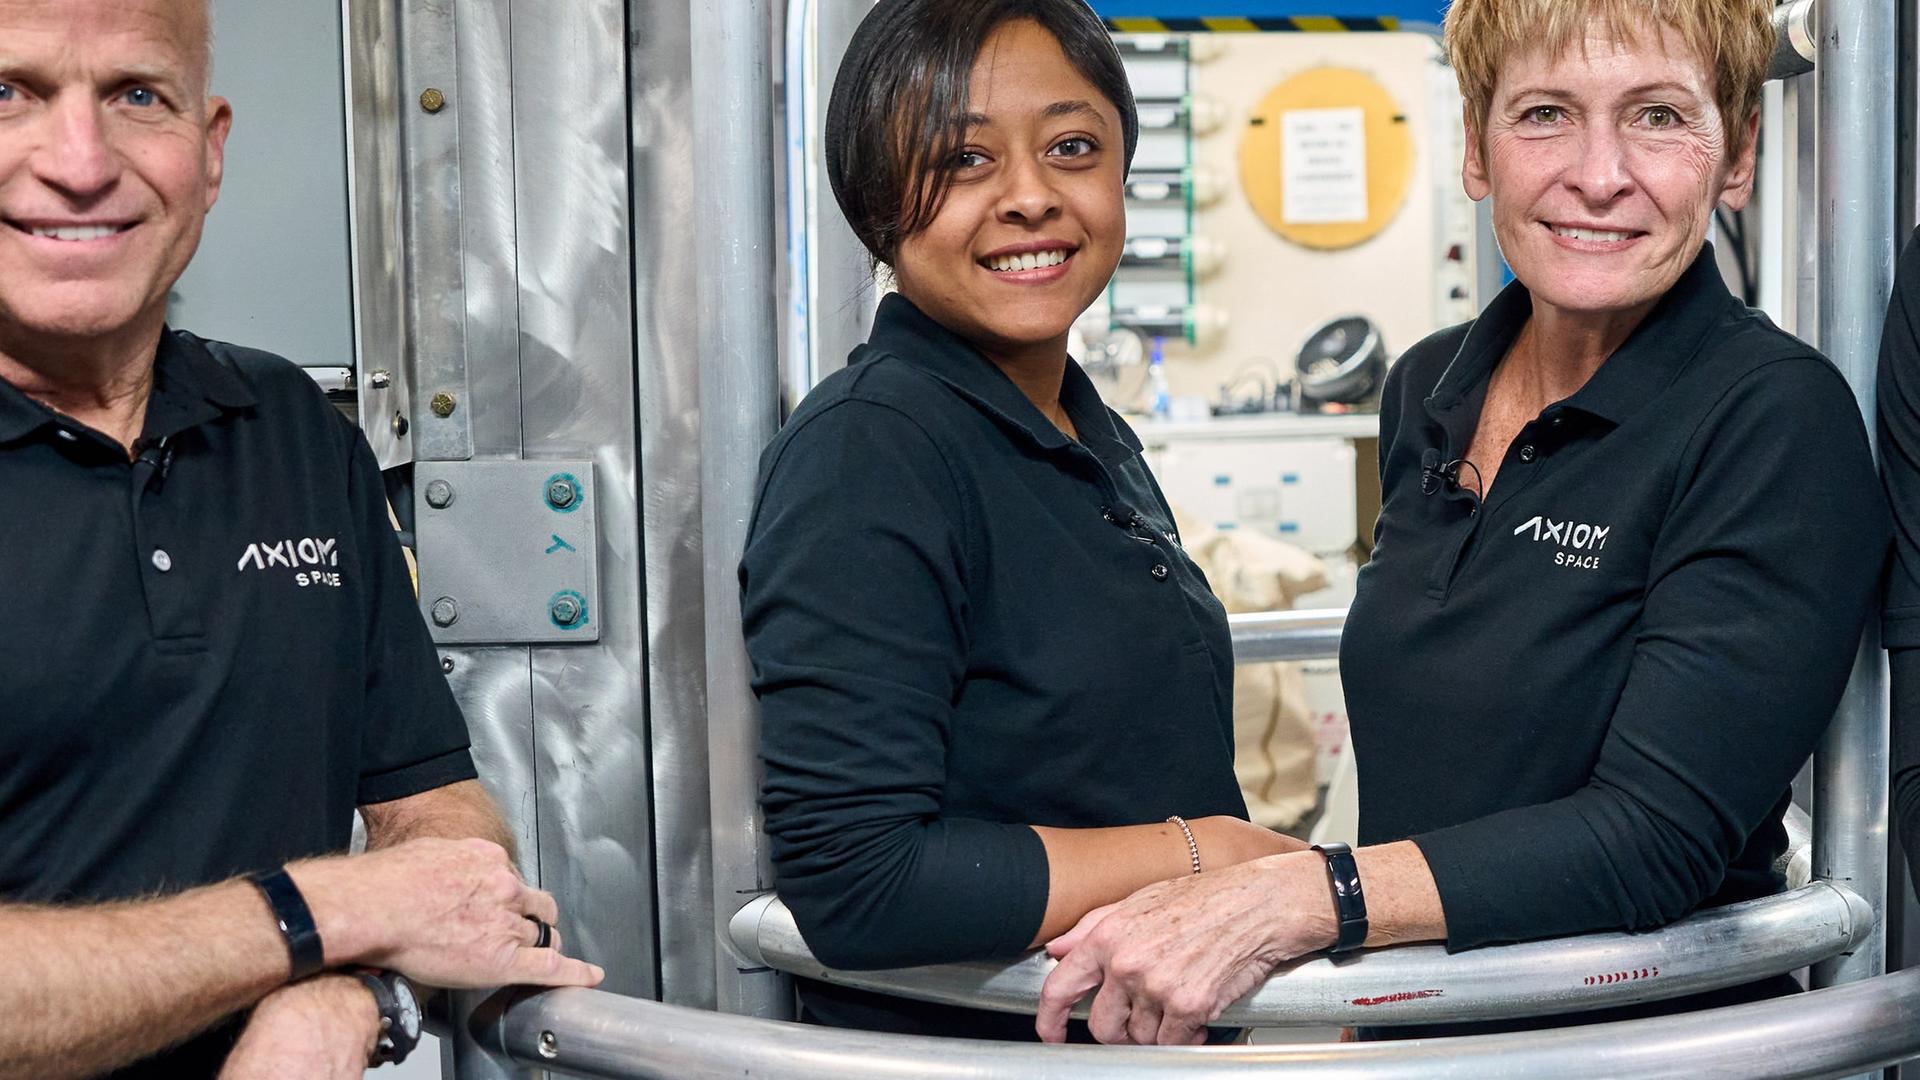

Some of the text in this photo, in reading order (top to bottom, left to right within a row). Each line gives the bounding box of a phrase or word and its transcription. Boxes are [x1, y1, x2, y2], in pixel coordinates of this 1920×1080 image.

[1513, 516, 1610, 550] AXIOM
[237, 538, 338, 571] AXIOM
[1554, 552, 1600, 569] SPACE
[295, 570, 341, 587] SPACE
